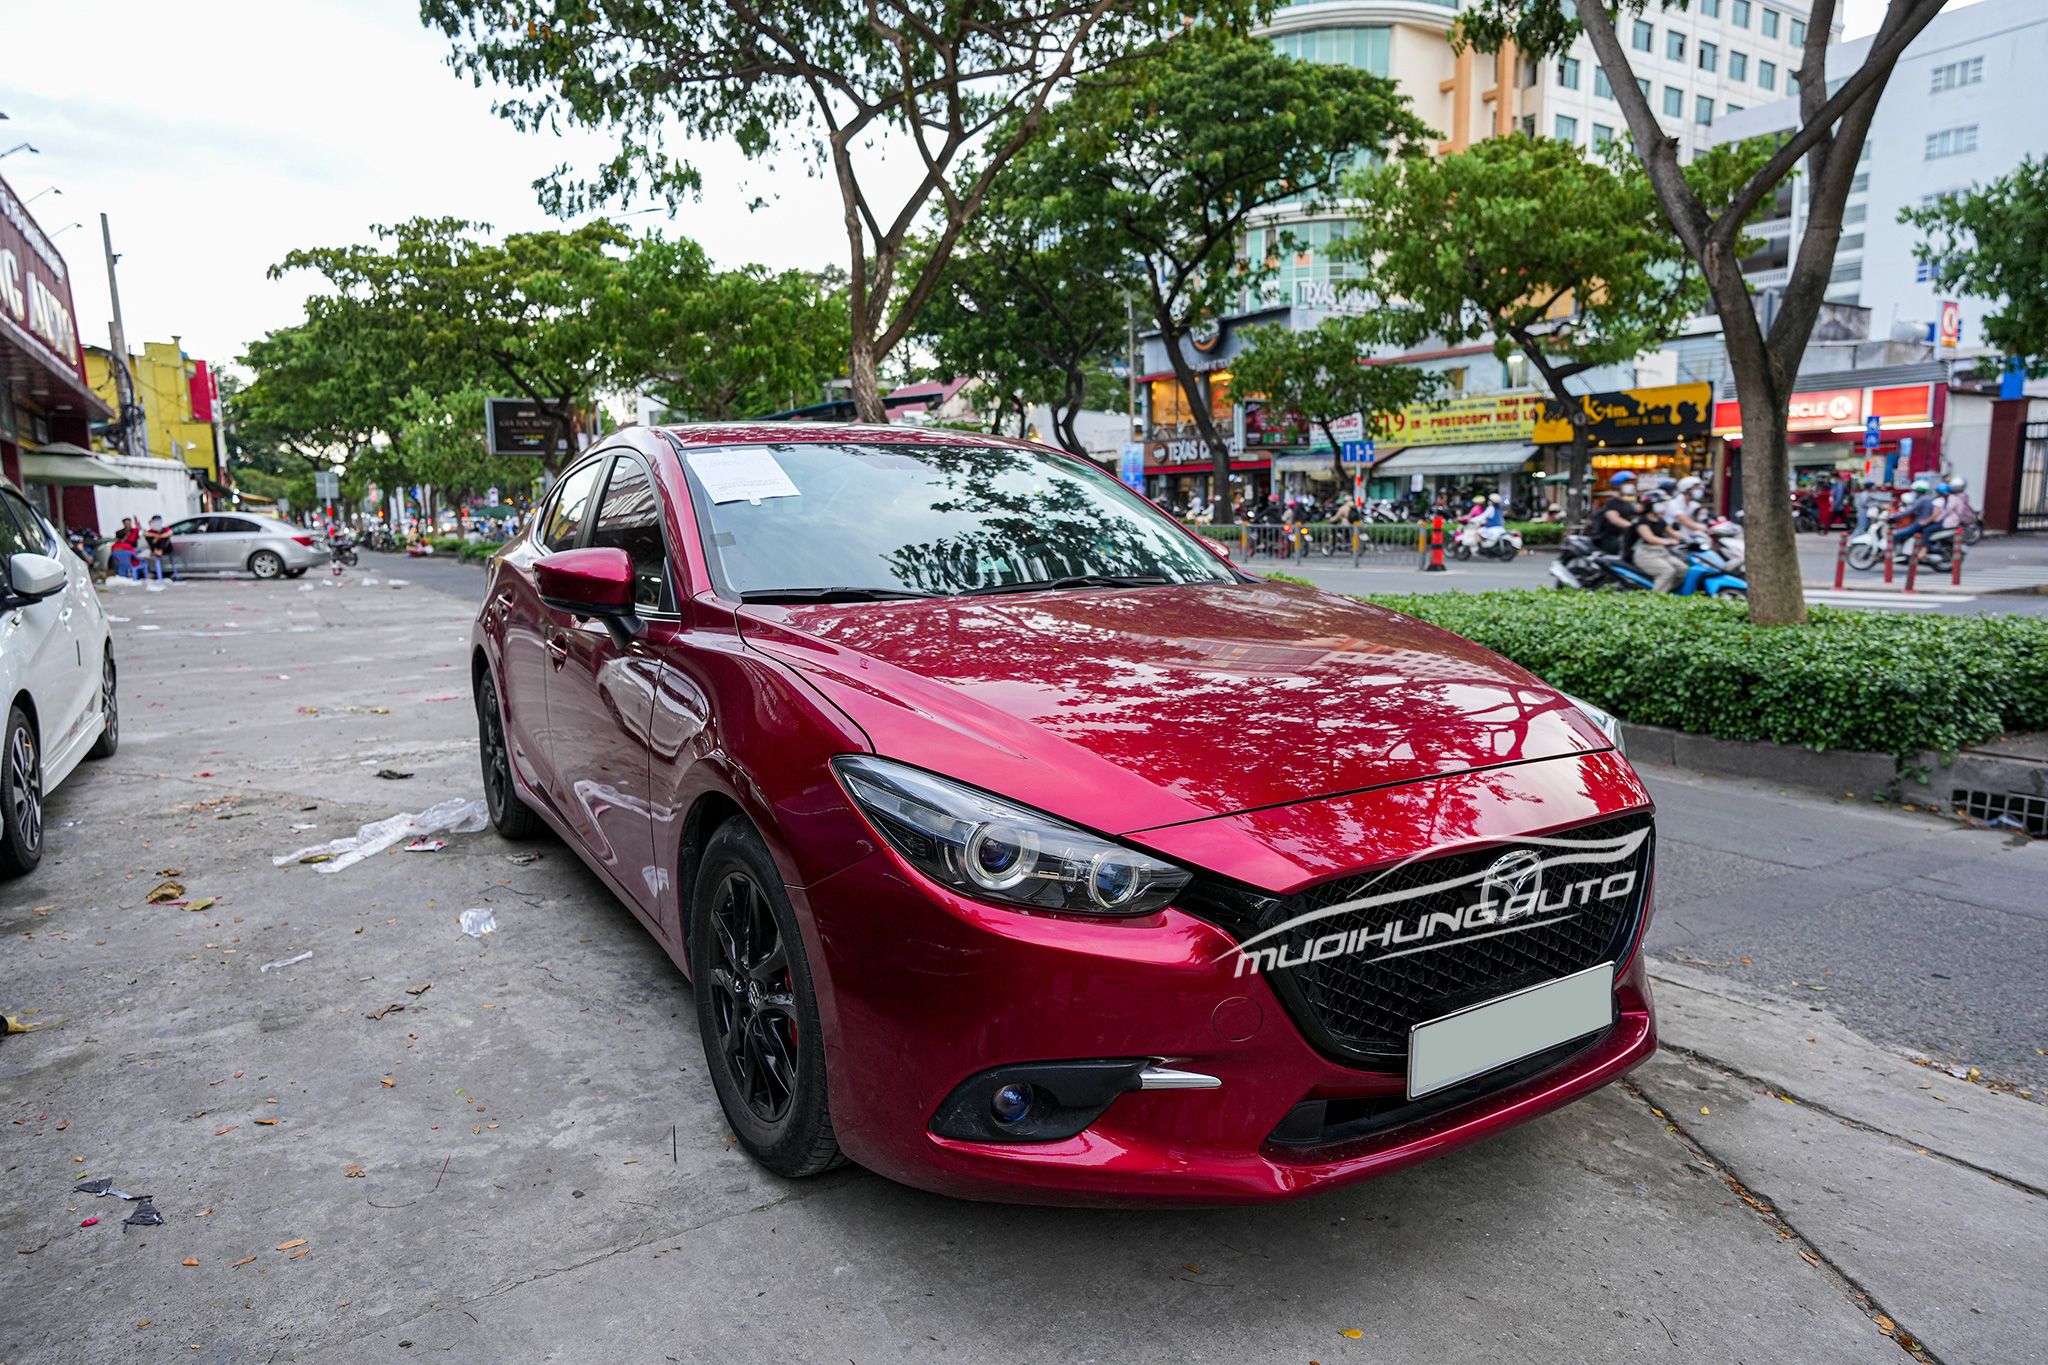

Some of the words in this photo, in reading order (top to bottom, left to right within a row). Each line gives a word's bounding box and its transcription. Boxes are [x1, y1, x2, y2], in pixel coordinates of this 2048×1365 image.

[1301, 282, 1338, 307] TEXAS
[1788, 402, 1827, 417] RCLE
[1168, 439, 1198, 465] TEXAS
